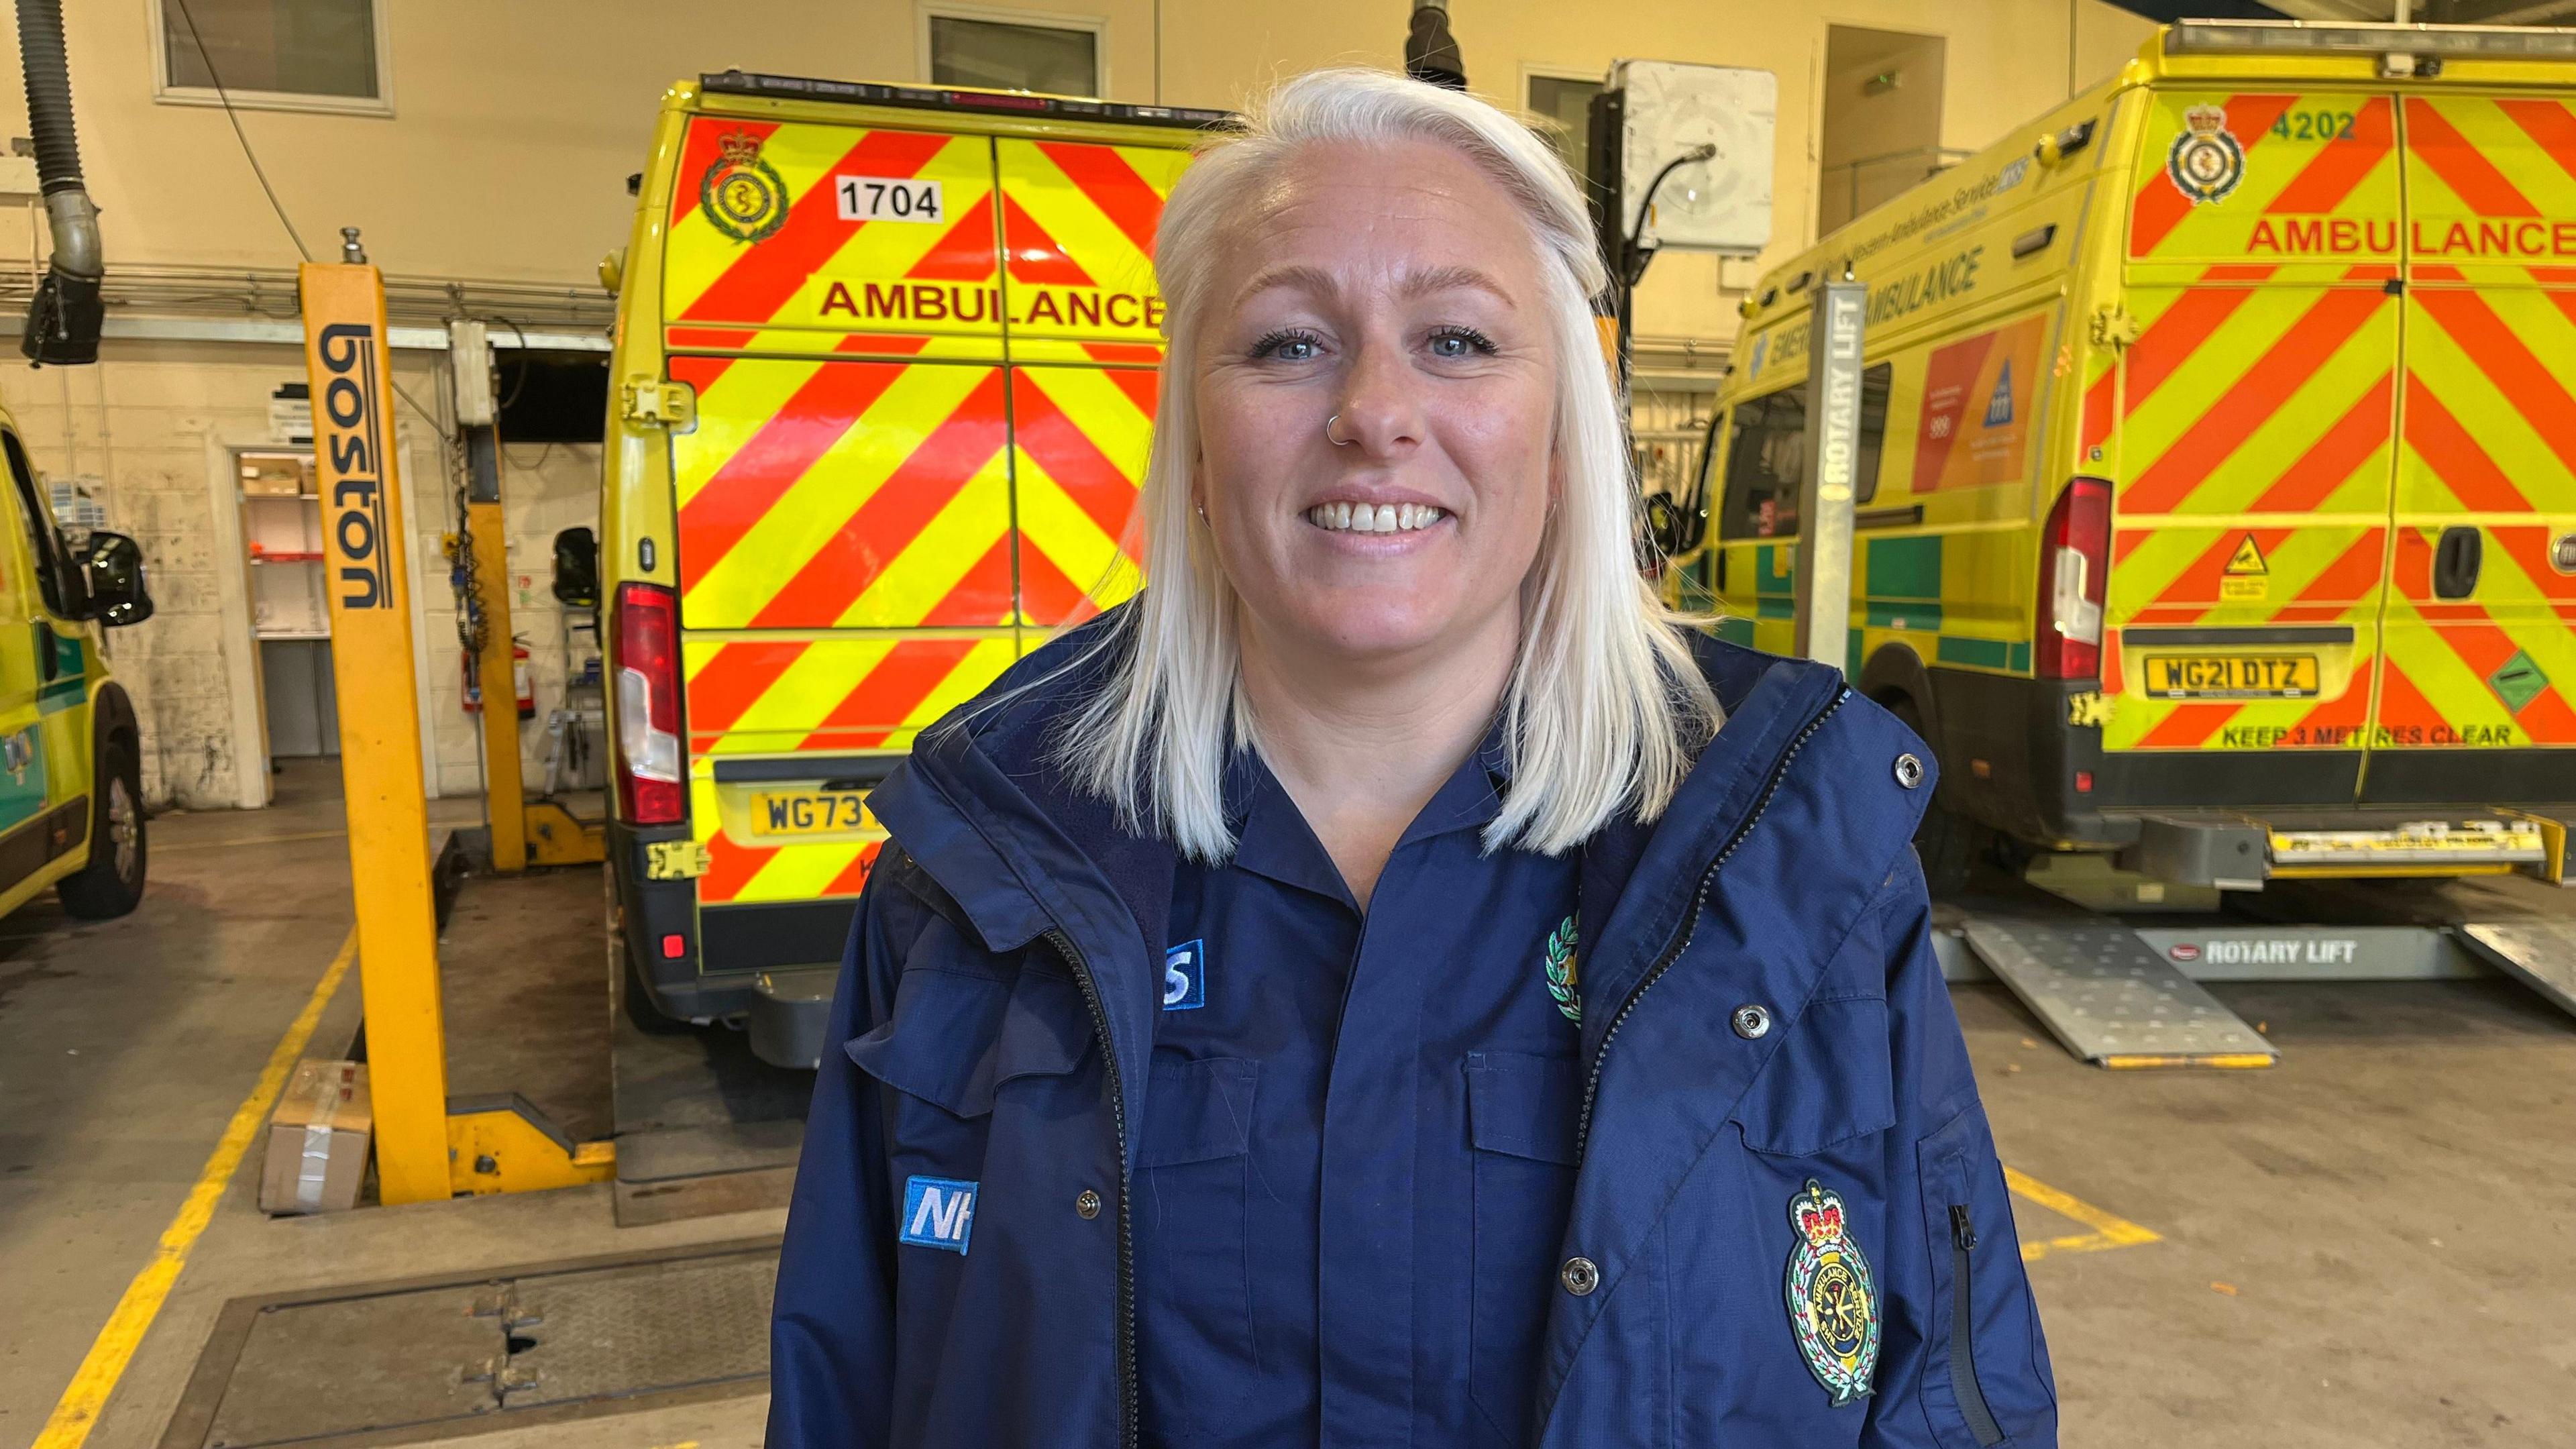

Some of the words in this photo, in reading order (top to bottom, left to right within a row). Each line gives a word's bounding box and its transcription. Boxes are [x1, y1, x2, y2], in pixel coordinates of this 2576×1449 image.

[2272, 111, 2356, 140] 4202
[842, 182, 937, 218] 1704
[2247, 219, 2576, 256] AMBULANCE
[819, 281, 1166, 329] AMBULANCE
[1831, 296, 1859, 360] LIFT
[1824, 367, 1855, 484] ROTARY
[1929, 415, 1950, 439] 999
[319, 324, 378, 609] boston
[2166, 661, 2233, 688] WG21
[2243, 659, 2299, 687] DTZ
[2222, 726, 2287, 747] KEEP
[2294, 726, 2306, 745] 3
[2430, 725, 2512, 745] CLEAR
[768, 797, 861, 829] WG73
[2205, 941, 2302, 964] ROTARY
[2306, 941, 2357, 964] LIFT
[910, 1186, 971, 1240] NH
[1815, 1267, 1847, 1313] AMBULANCE
[1849, 1282, 1863, 1340] SERVICE
[1821, 1320, 1836, 1346] NHS
